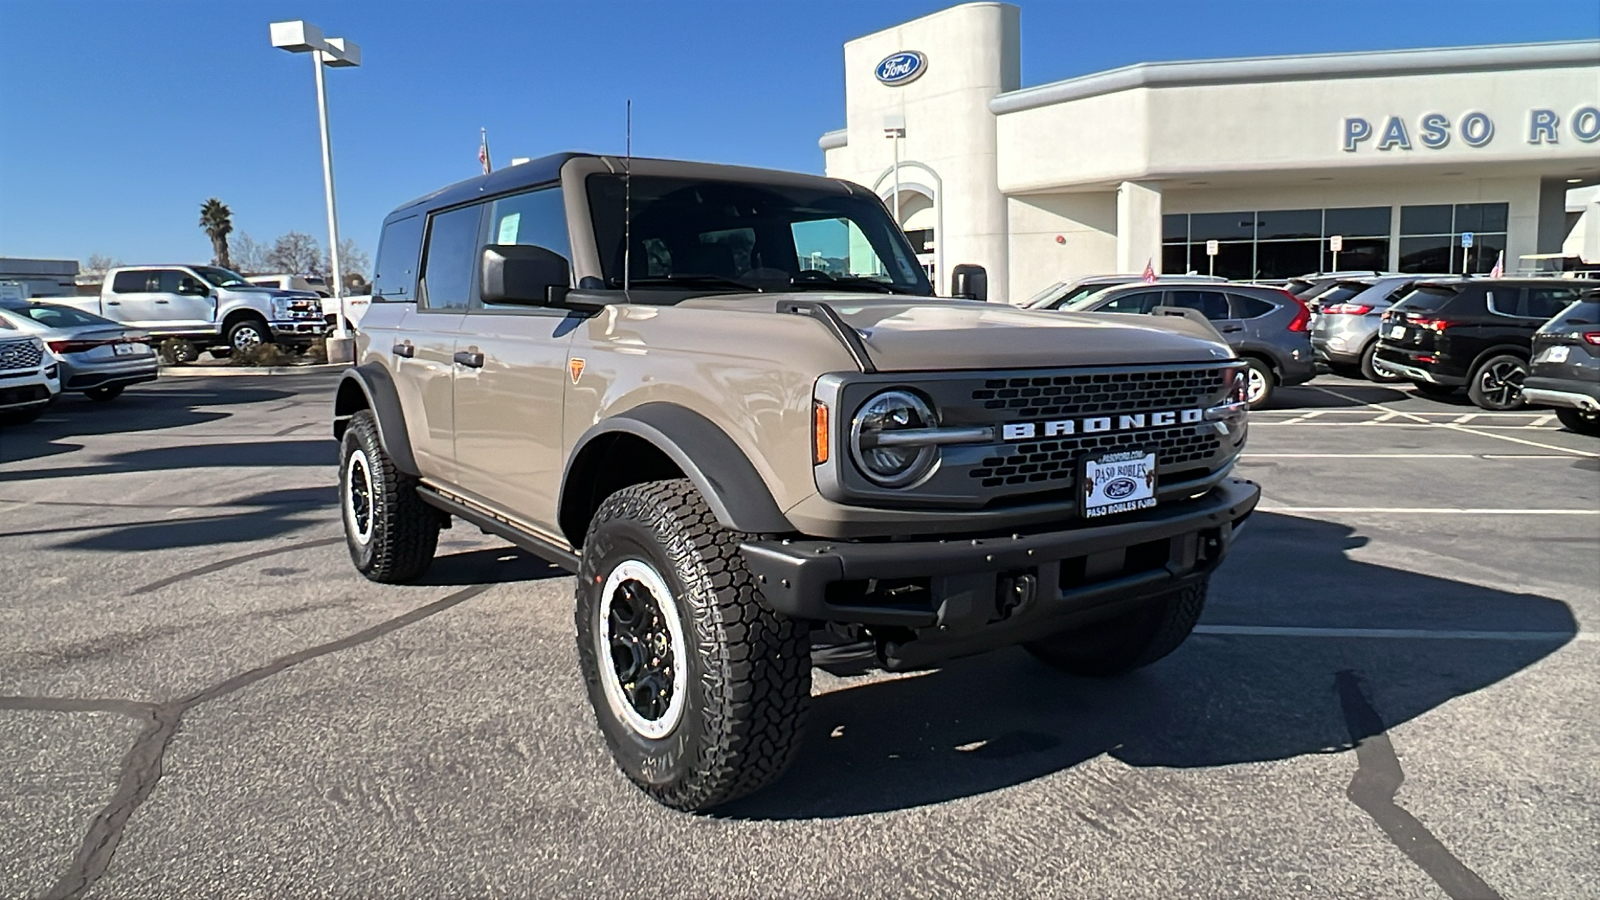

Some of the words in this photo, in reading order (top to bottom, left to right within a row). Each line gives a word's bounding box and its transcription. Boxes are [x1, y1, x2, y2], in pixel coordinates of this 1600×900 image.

[882, 57, 911, 79] Ford
[1342, 111, 1496, 152] PASO
[1002, 408, 1203, 440] BRONCO
[1095, 467, 1115, 486] PASO
[1117, 463, 1146, 479] ROBLES
[1110, 481, 1131, 496] Ford
[1086, 506, 1107, 518] PASO
[1108, 500, 1137, 514] ROBLES
[1138, 498, 1157, 508] FORD
